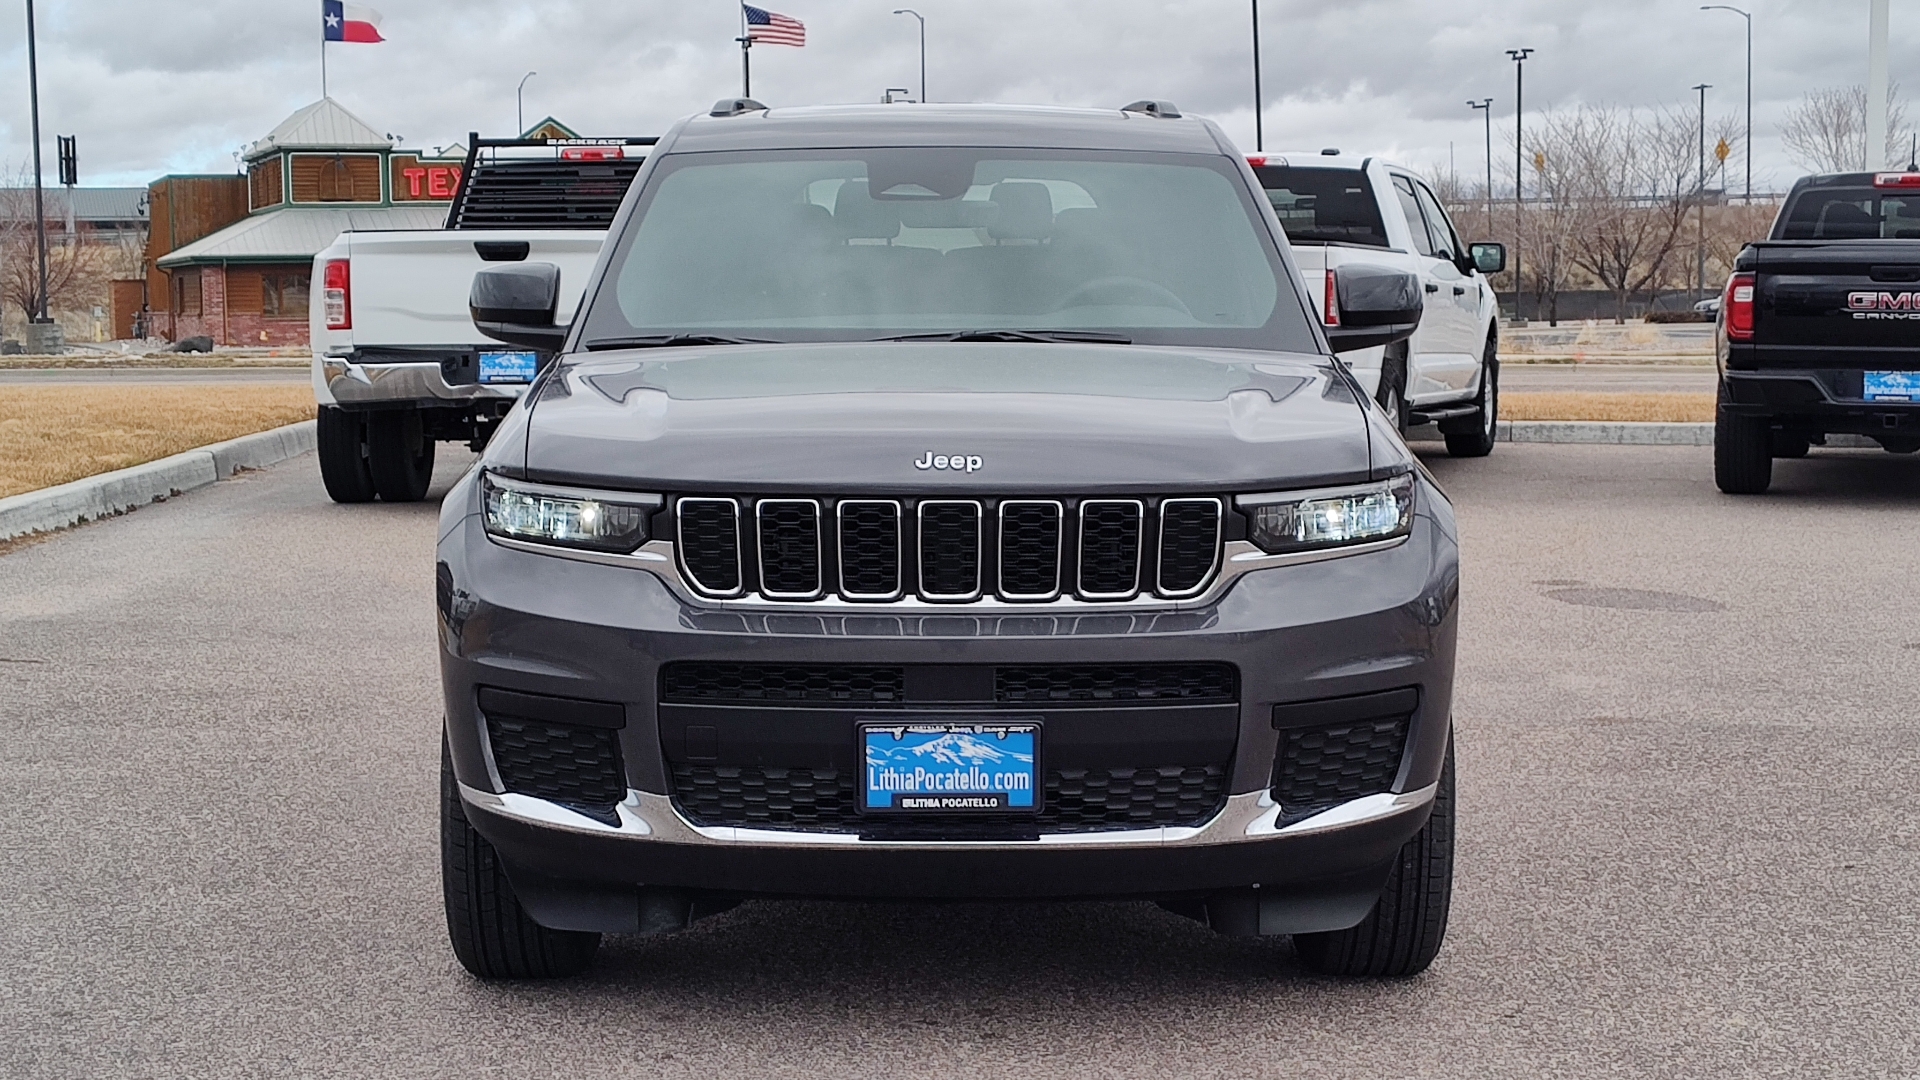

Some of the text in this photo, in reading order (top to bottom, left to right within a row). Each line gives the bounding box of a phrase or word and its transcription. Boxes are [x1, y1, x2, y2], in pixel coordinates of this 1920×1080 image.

[546, 138, 627, 146] BACKRACK
[1847, 291, 1920, 310] GM
[914, 450, 983, 474] Jeep
[869, 766, 1030, 791] LithiaPocatello.com
[911, 797, 998, 808] LITHIA POCATELLO
